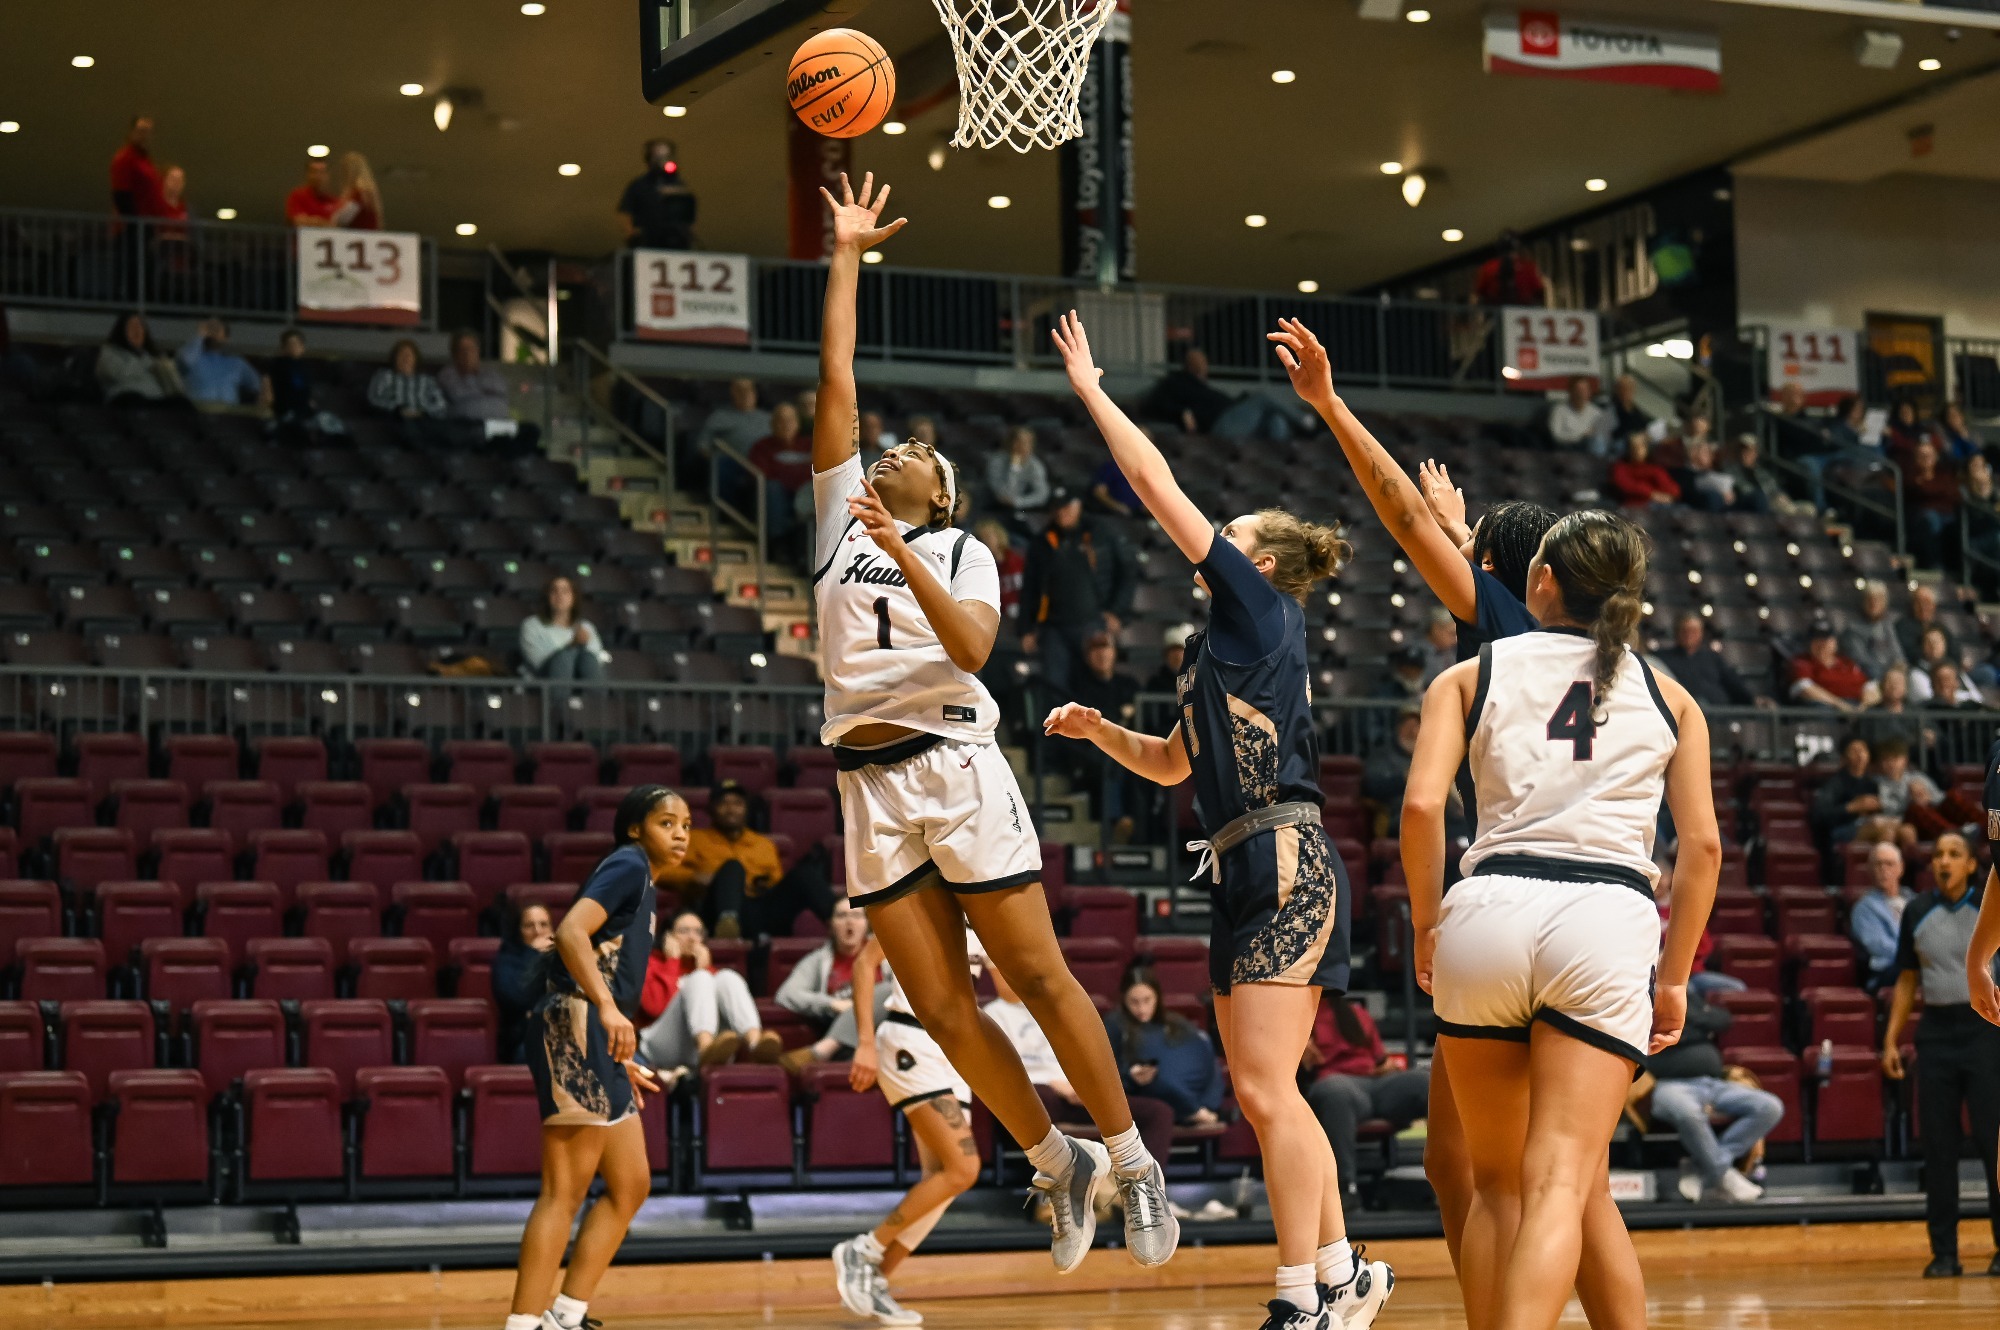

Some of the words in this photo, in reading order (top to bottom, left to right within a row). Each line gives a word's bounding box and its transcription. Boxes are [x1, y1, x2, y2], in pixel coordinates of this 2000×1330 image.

[1570, 26, 1664, 56] TOYOTA
[787, 66, 842, 103] Wilson
[811, 100, 846, 128] EVO
[314, 237, 402, 287] 113
[649, 259, 735, 294] 112
[1516, 316, 1588, 347] 112
[1780, 332, 1846, 364] 111
[840, 552, 908, 588] Haw
[872, 596, 893, 650] 1
[1546, 680, 1597, 762] 4
